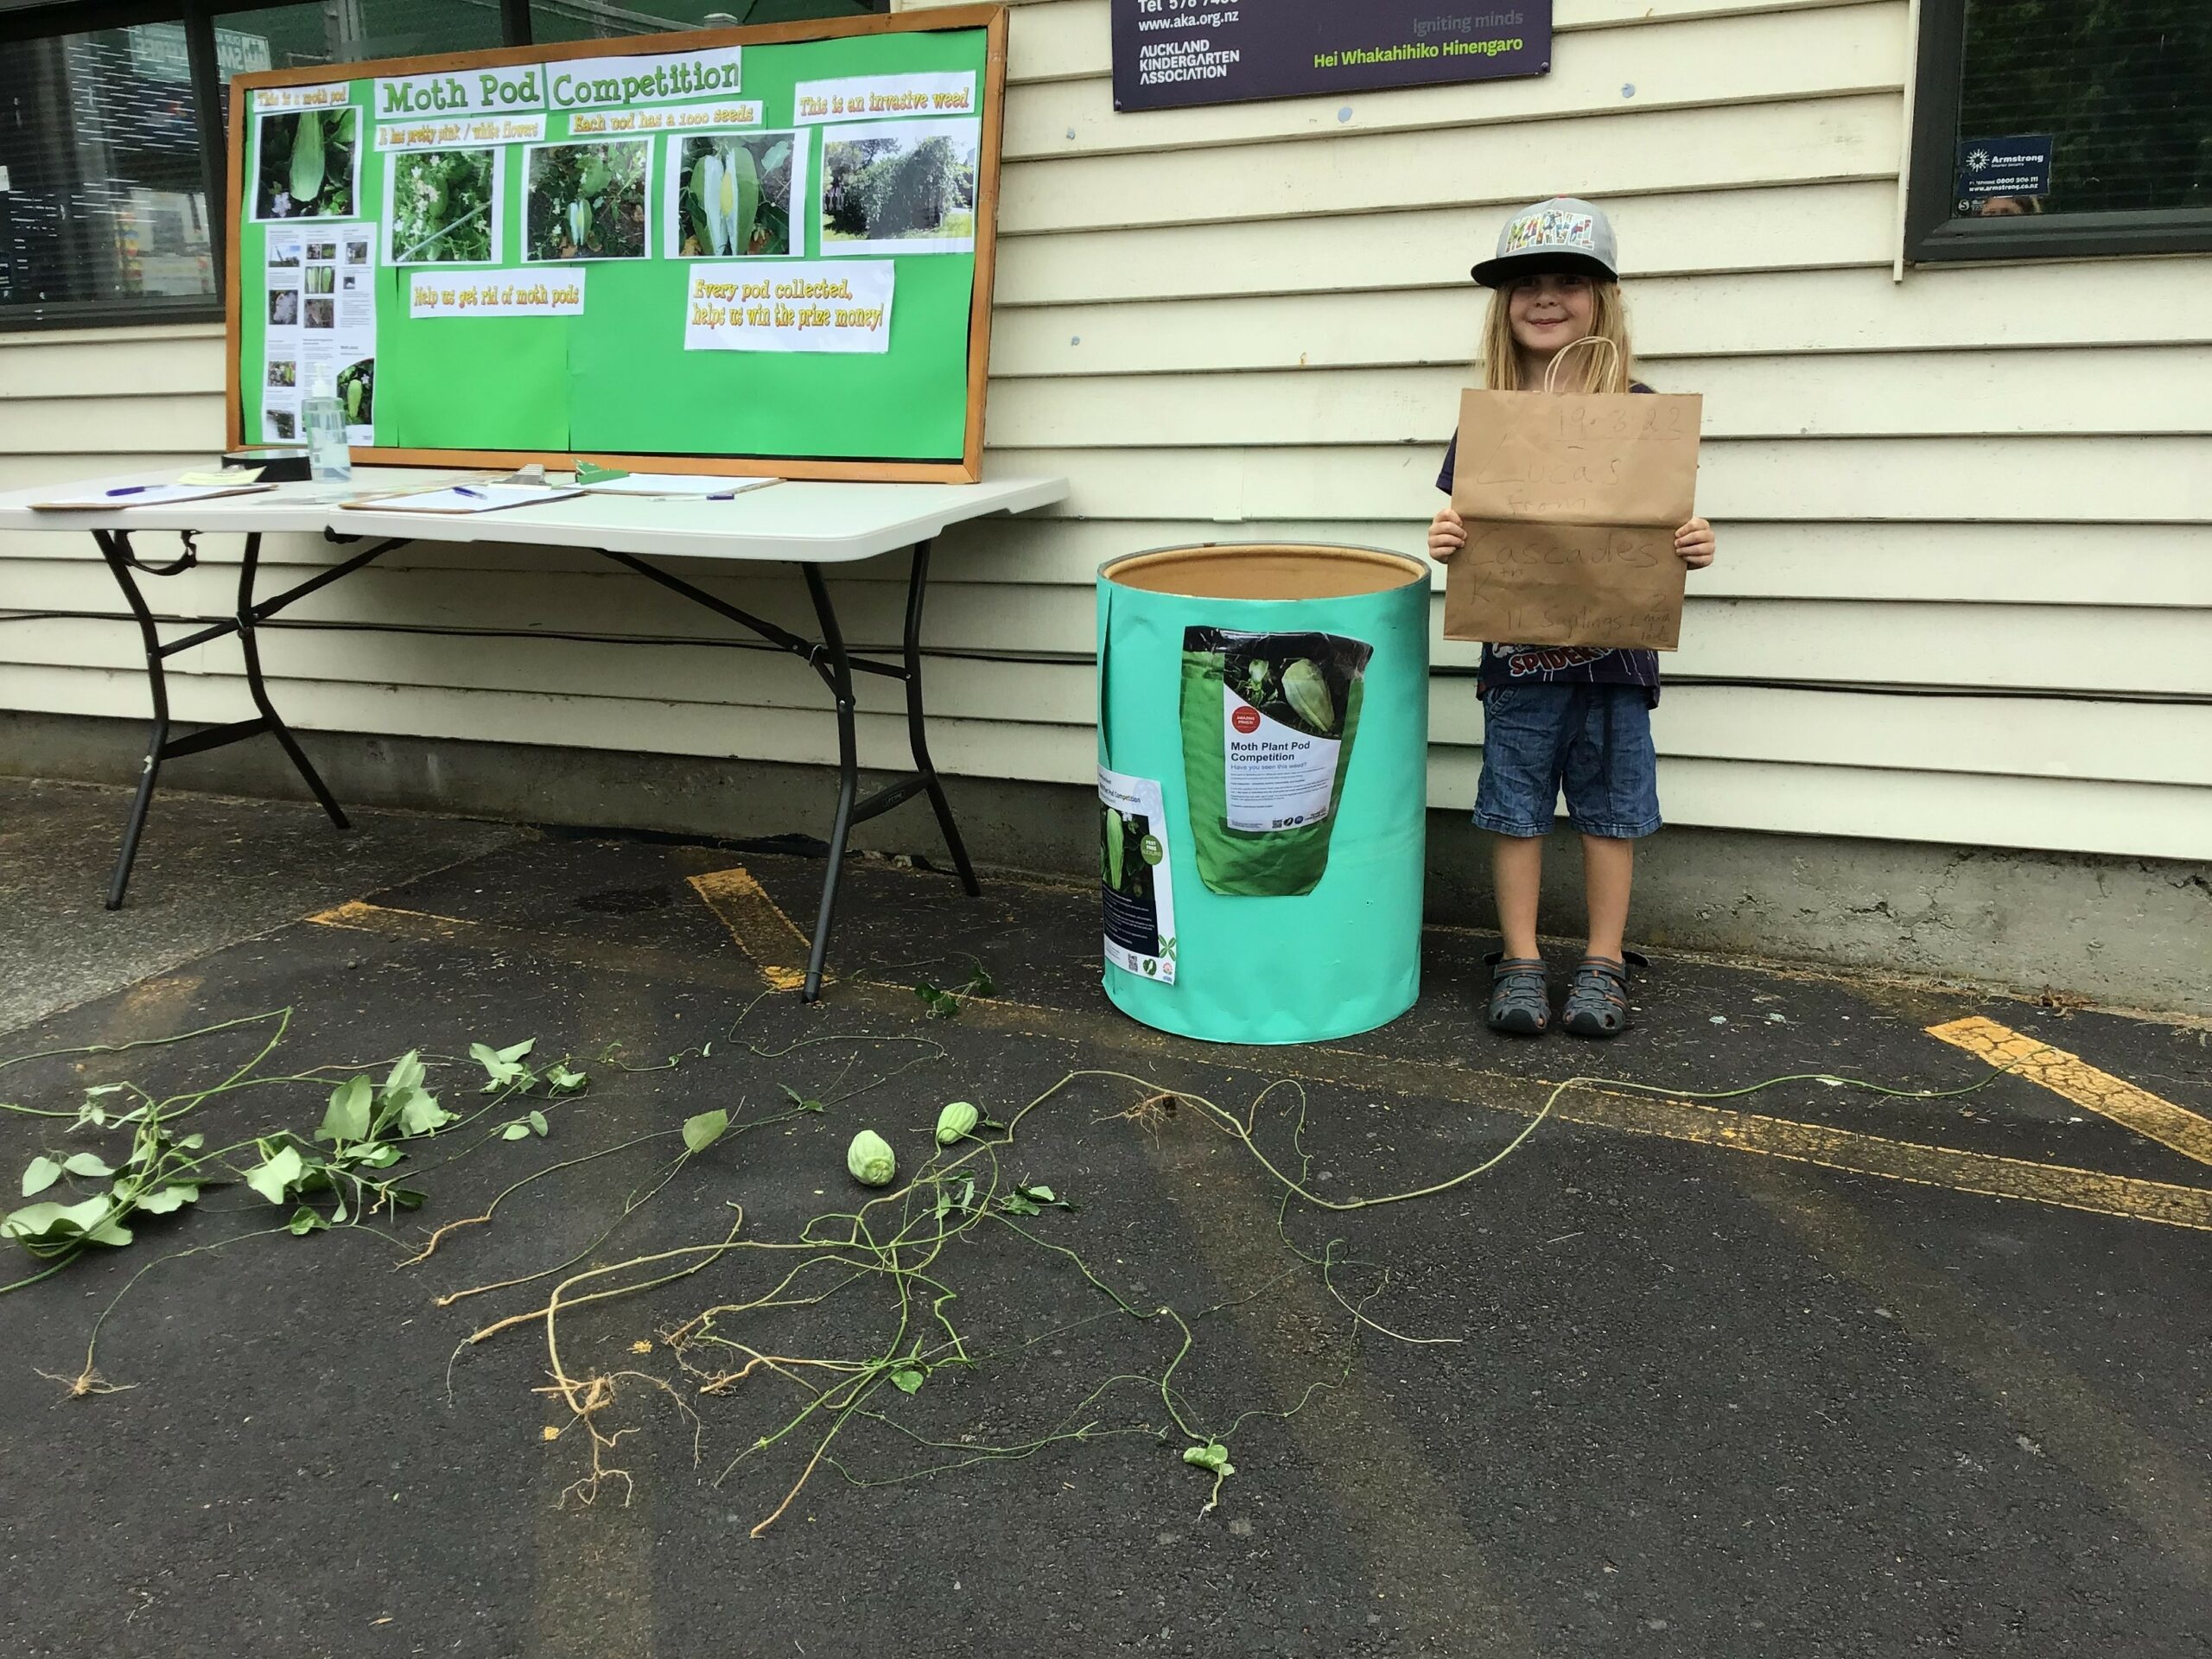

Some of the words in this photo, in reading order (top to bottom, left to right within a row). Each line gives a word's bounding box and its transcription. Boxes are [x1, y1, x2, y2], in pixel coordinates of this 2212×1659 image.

[1138, 10, 1239, 31] www.aka.org.nz
[1414, 16, 1471, 36] Igniting
[1475, 10, 1523, 29] minds
[1139, 49, 1240, 72] KINDERGARTEN
[1140, 39, 1210, 59] AUCKLAND
[1314, 51, 1338, 68] Hei
[1341, 41, 1438, 66] Whakahihiko
[1442, 37, 1523, 57] Hinengaro
[553, 60, 739, 105] Competition
[1140, 65, 1227, 85] ASSOCIATION
[383, 78, 468, 113] Moth
[479, 71, 540, 106] Pod
[800, 96, 828, 116] This
[832, 93, 843, 114] is
[847, 96, 865, 113] an
[869, 90, 928, 111] invasive
[932, 86, 969, 110] weed
[573, 114, 605, 132] Each
[639, 111, 662, 128] has
[666, 114, 675, 127] a
[679, 114, 709, 126] 1000
[713, 105, 753, 123] seeds
[390, 127, 404, 144] has
[407, 124, 436, 146] pretty
[438, 123, 461, 144] pink
[472, 122, 499, 140] white
[503, 120, 538, 139] flowers
[1991, 155, 2044, 163] Armstrong
[1968, 183, 2038, 192] www.armstrong.co.nz
[1506, 209, 1595, 253] MARVEL
[414, 286, 438, 308] Help
[442, 289, 455, 305] us
[459, 286, 478, 308] get
[480, 285, 499, 305] rid
[501, 284, 514, 305] of
[516, 283, 549, 305] moth
[551, 284, 579, 308] pods
[693, 278, 738, 302] Every
[741, 278, 770, 302] pod
[774, 278, 853, 300] collected,
[691, 302, 726, 329] helps
[728, 307, 743, 327] us
[746, 302, 771, 327] win
[774, 302, 795, 327] the
[798, 303, 830, 331] prize
[834, 302, 885, 332] money!
[1230, 741, 1258, 751] Moth
[1262, 741, 1288, 751] Plant
[1291, 741, 1310, 750] Pod
[1230, 753, 1294, 763] Competition
[1115, 791, 1141, 803] Competition
